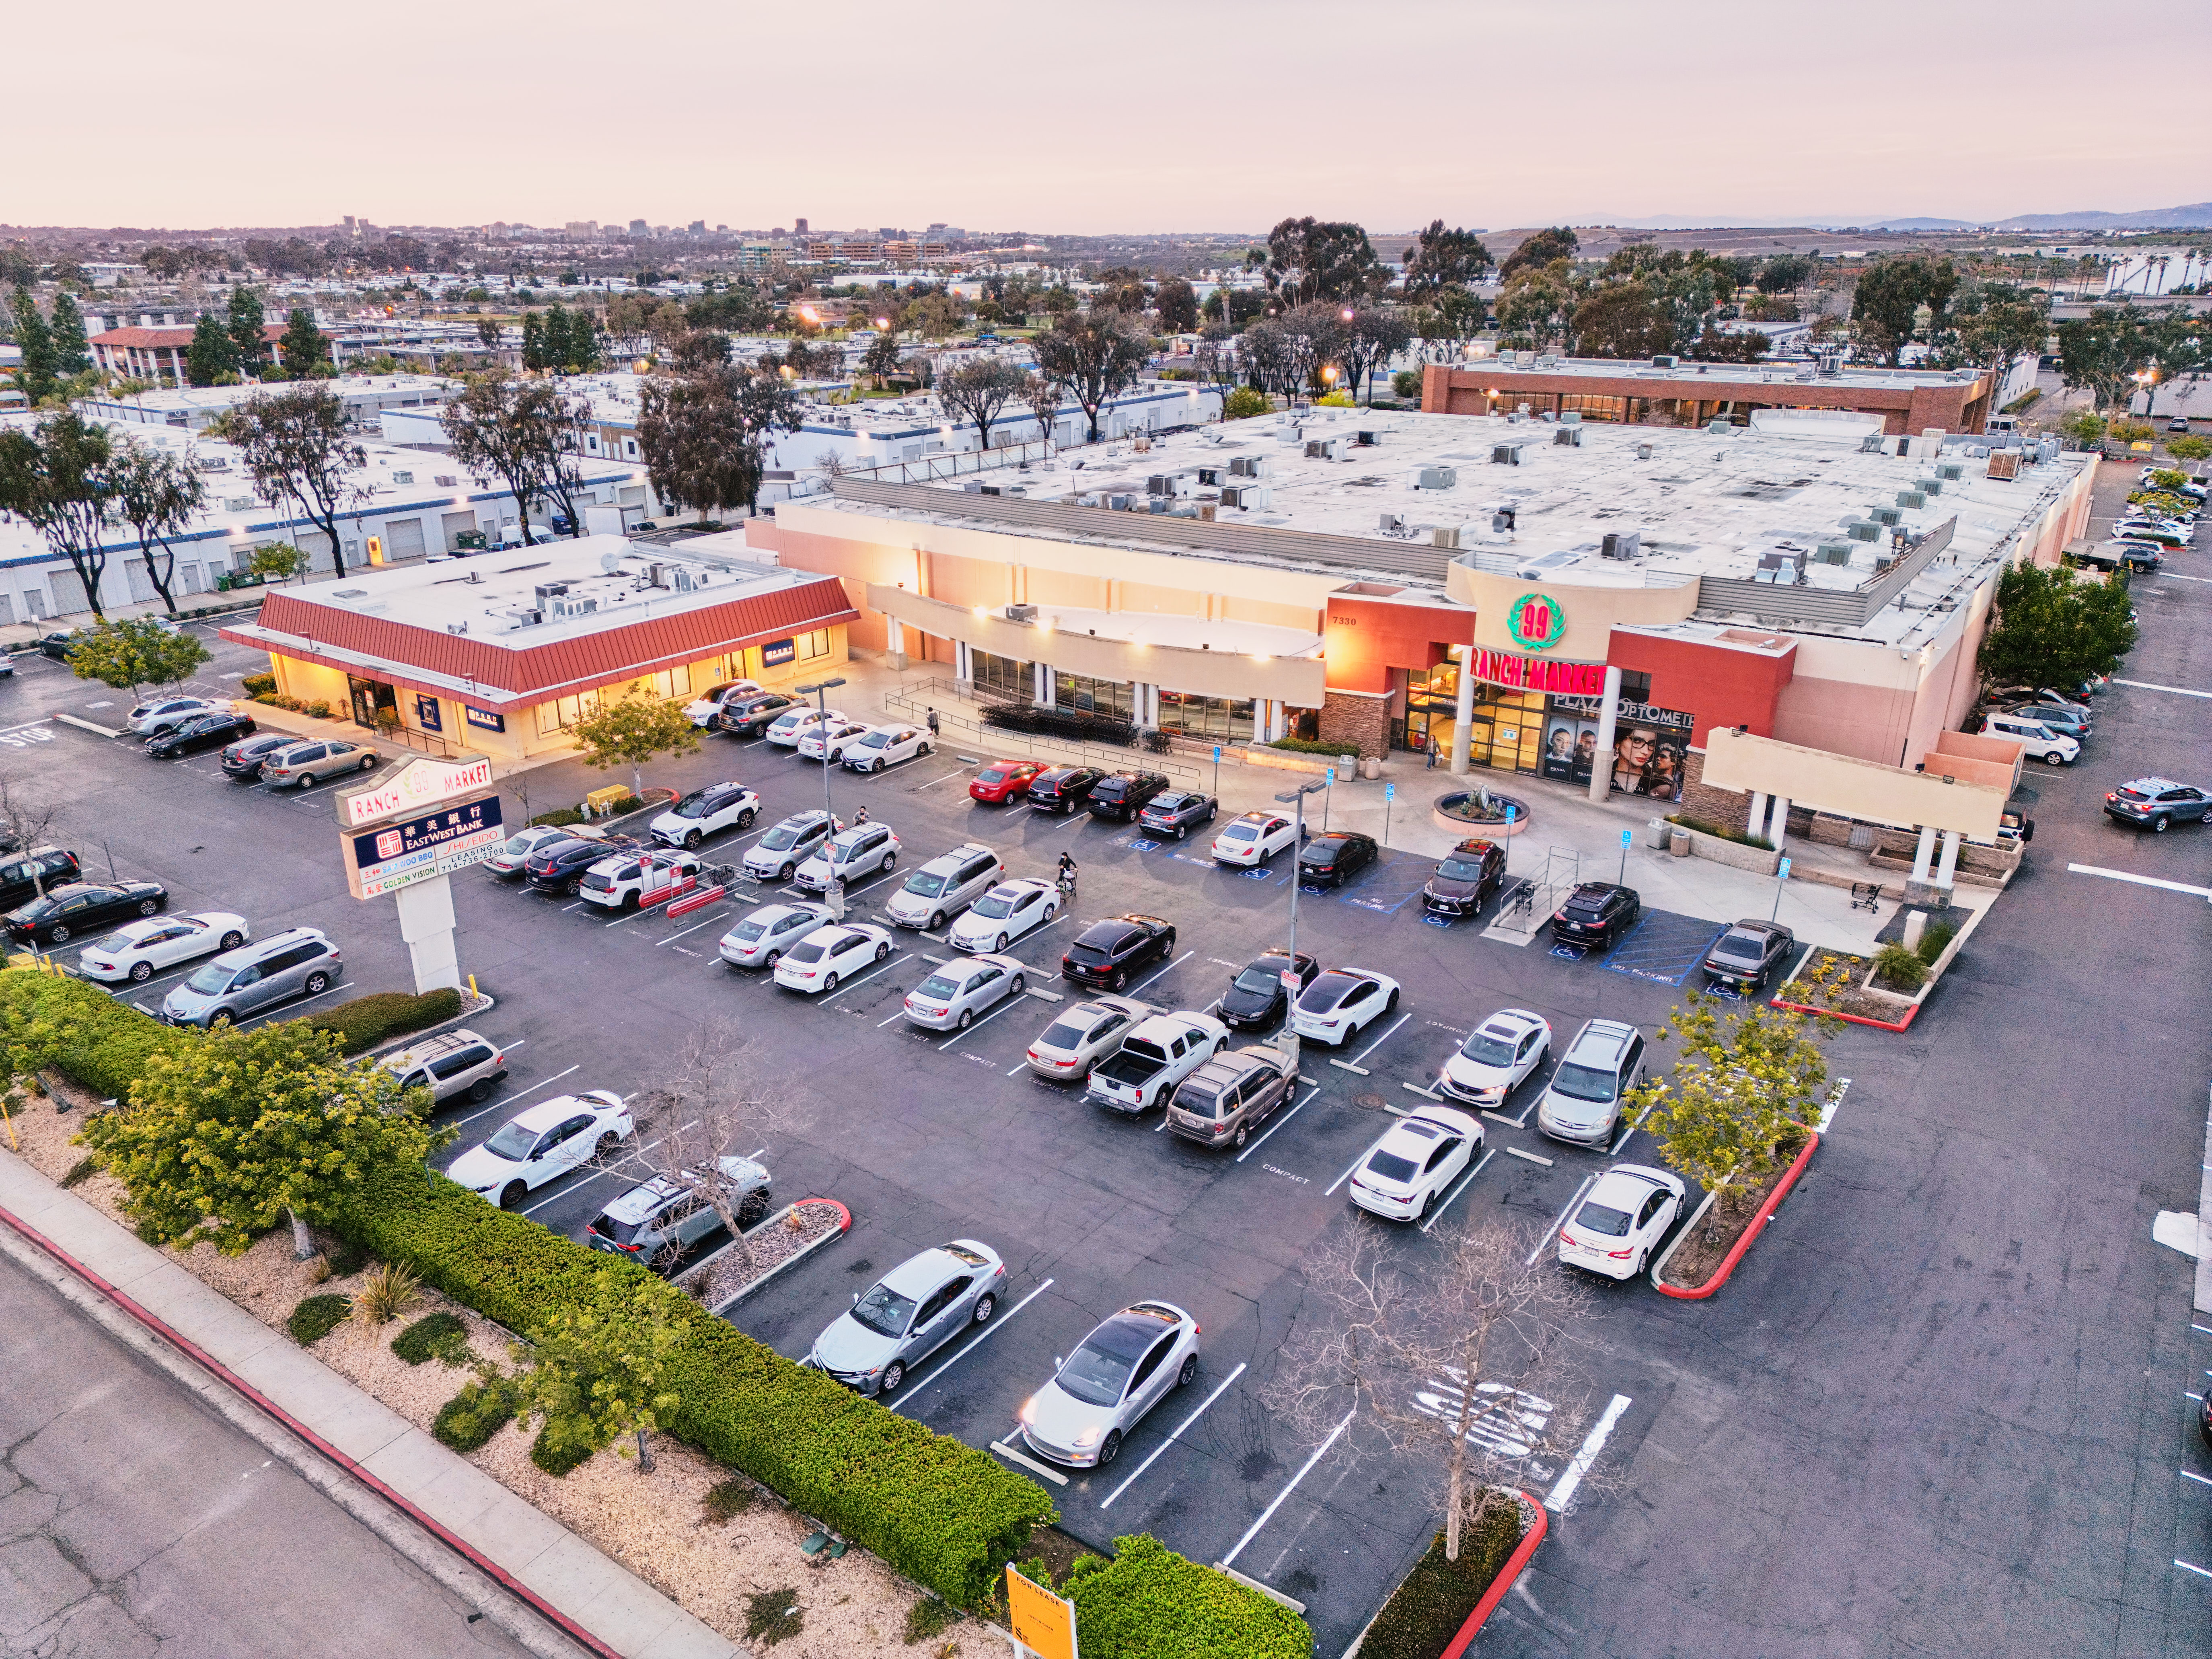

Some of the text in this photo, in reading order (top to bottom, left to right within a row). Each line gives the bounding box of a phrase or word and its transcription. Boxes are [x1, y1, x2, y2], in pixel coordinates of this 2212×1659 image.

[1333, 616, 1357, 625] 7330
[1523, 604, 1550, 639] 99
[1470, 646, 1606, 695] RANCH MARKET
[0, 728, 56, 746] STOP
[356, 764, 487, 818] RANCH MARKET
[414, 770, 429, 793] 99
[404, 806, 481, 837] 華美銀行
[456, 819, 483, 835] BANK
[443, 831, 497, 854] SHISEIDO
[442, 847, 503, 872] 714-736-2700
[451, 845, 492, 862] LEASING
[365, 851, 433, 878] 三和 SAM WOO BBQ
[384, 874, 411, 888] GOLDEN
[412, 866, 435, 879] VISION
[575, 910, 603, 921] COMPACT
[672, 946, 703, 958] COMPACT
[1207, 957, 1243, 970] COMPACT
[1425, 1020, 1468, 1035] COMPACT
[959, 1051, 997, 1068] COMPACT
[1028, 1077, 1068, 1094] COMPACT
[1262, 1164, 1311, 1184] COMPACT
[1017, 1576, 1032, 1589] FOR
[1035, 1588, 1060, 1607] LEASE
